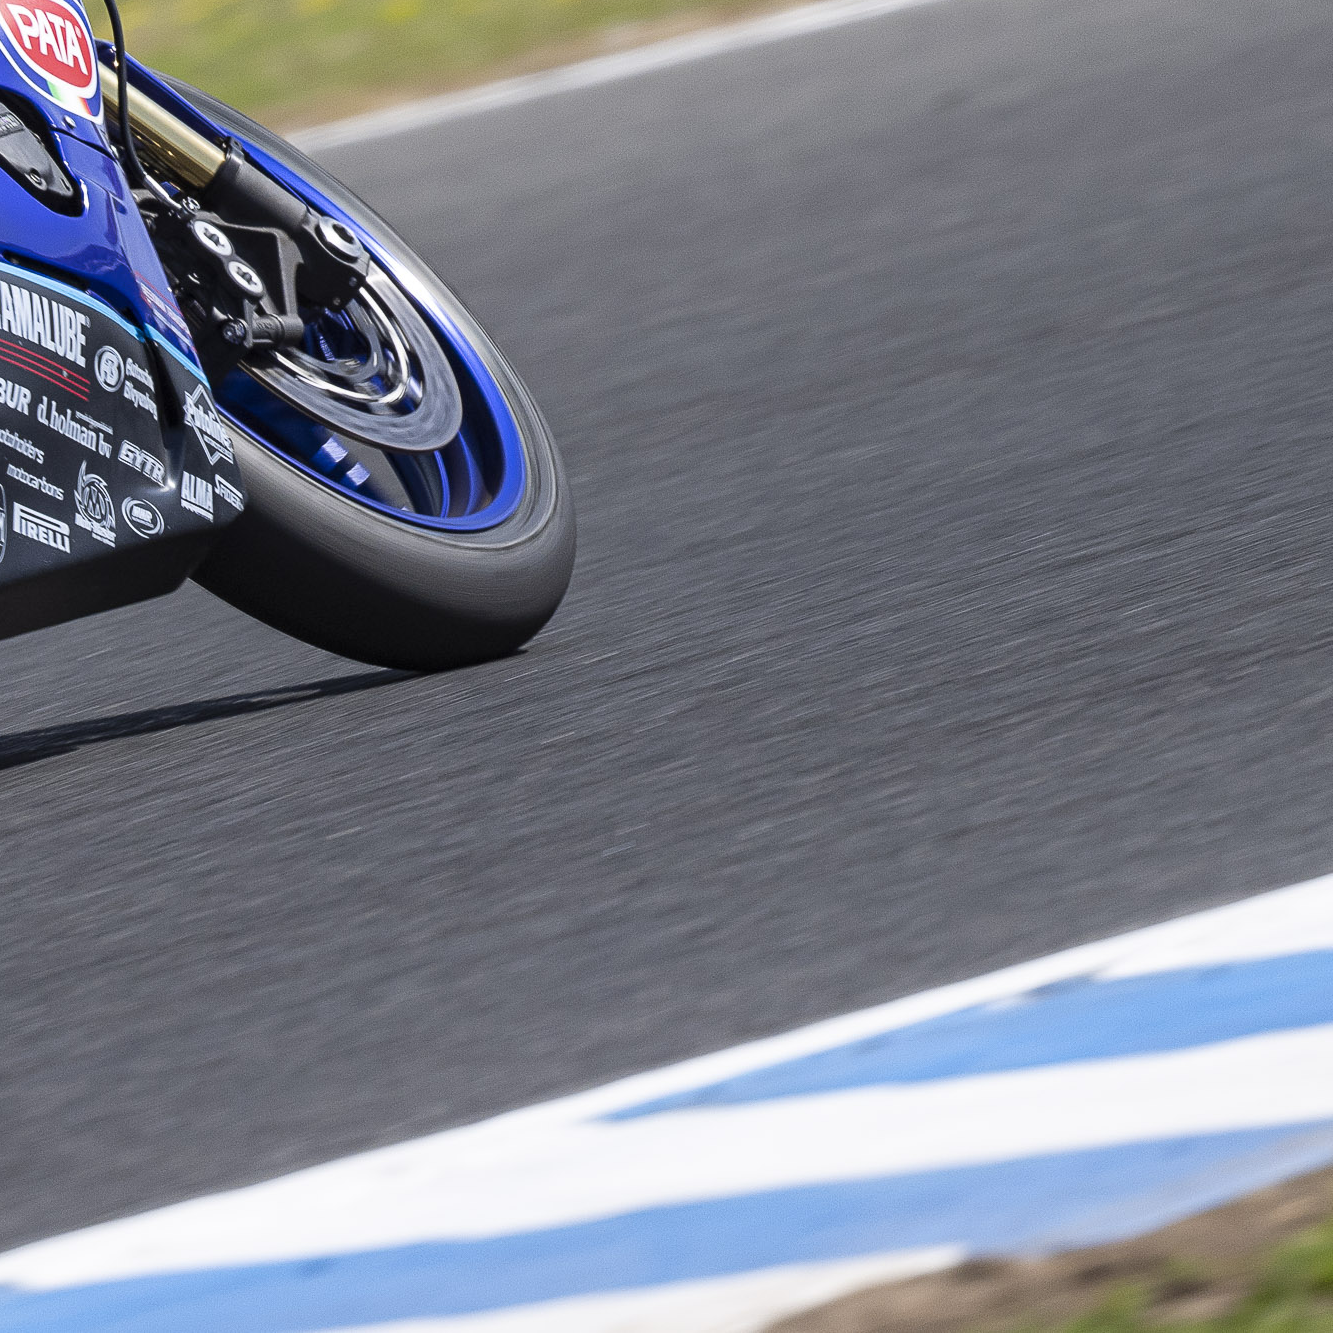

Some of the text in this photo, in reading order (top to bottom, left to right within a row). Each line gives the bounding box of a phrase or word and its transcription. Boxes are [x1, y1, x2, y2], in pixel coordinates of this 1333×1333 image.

[6, 3, 89, 76] PATA
[119, 440, 166, 486] GYTR
[13, 501, 71, 554] PIRELLI
